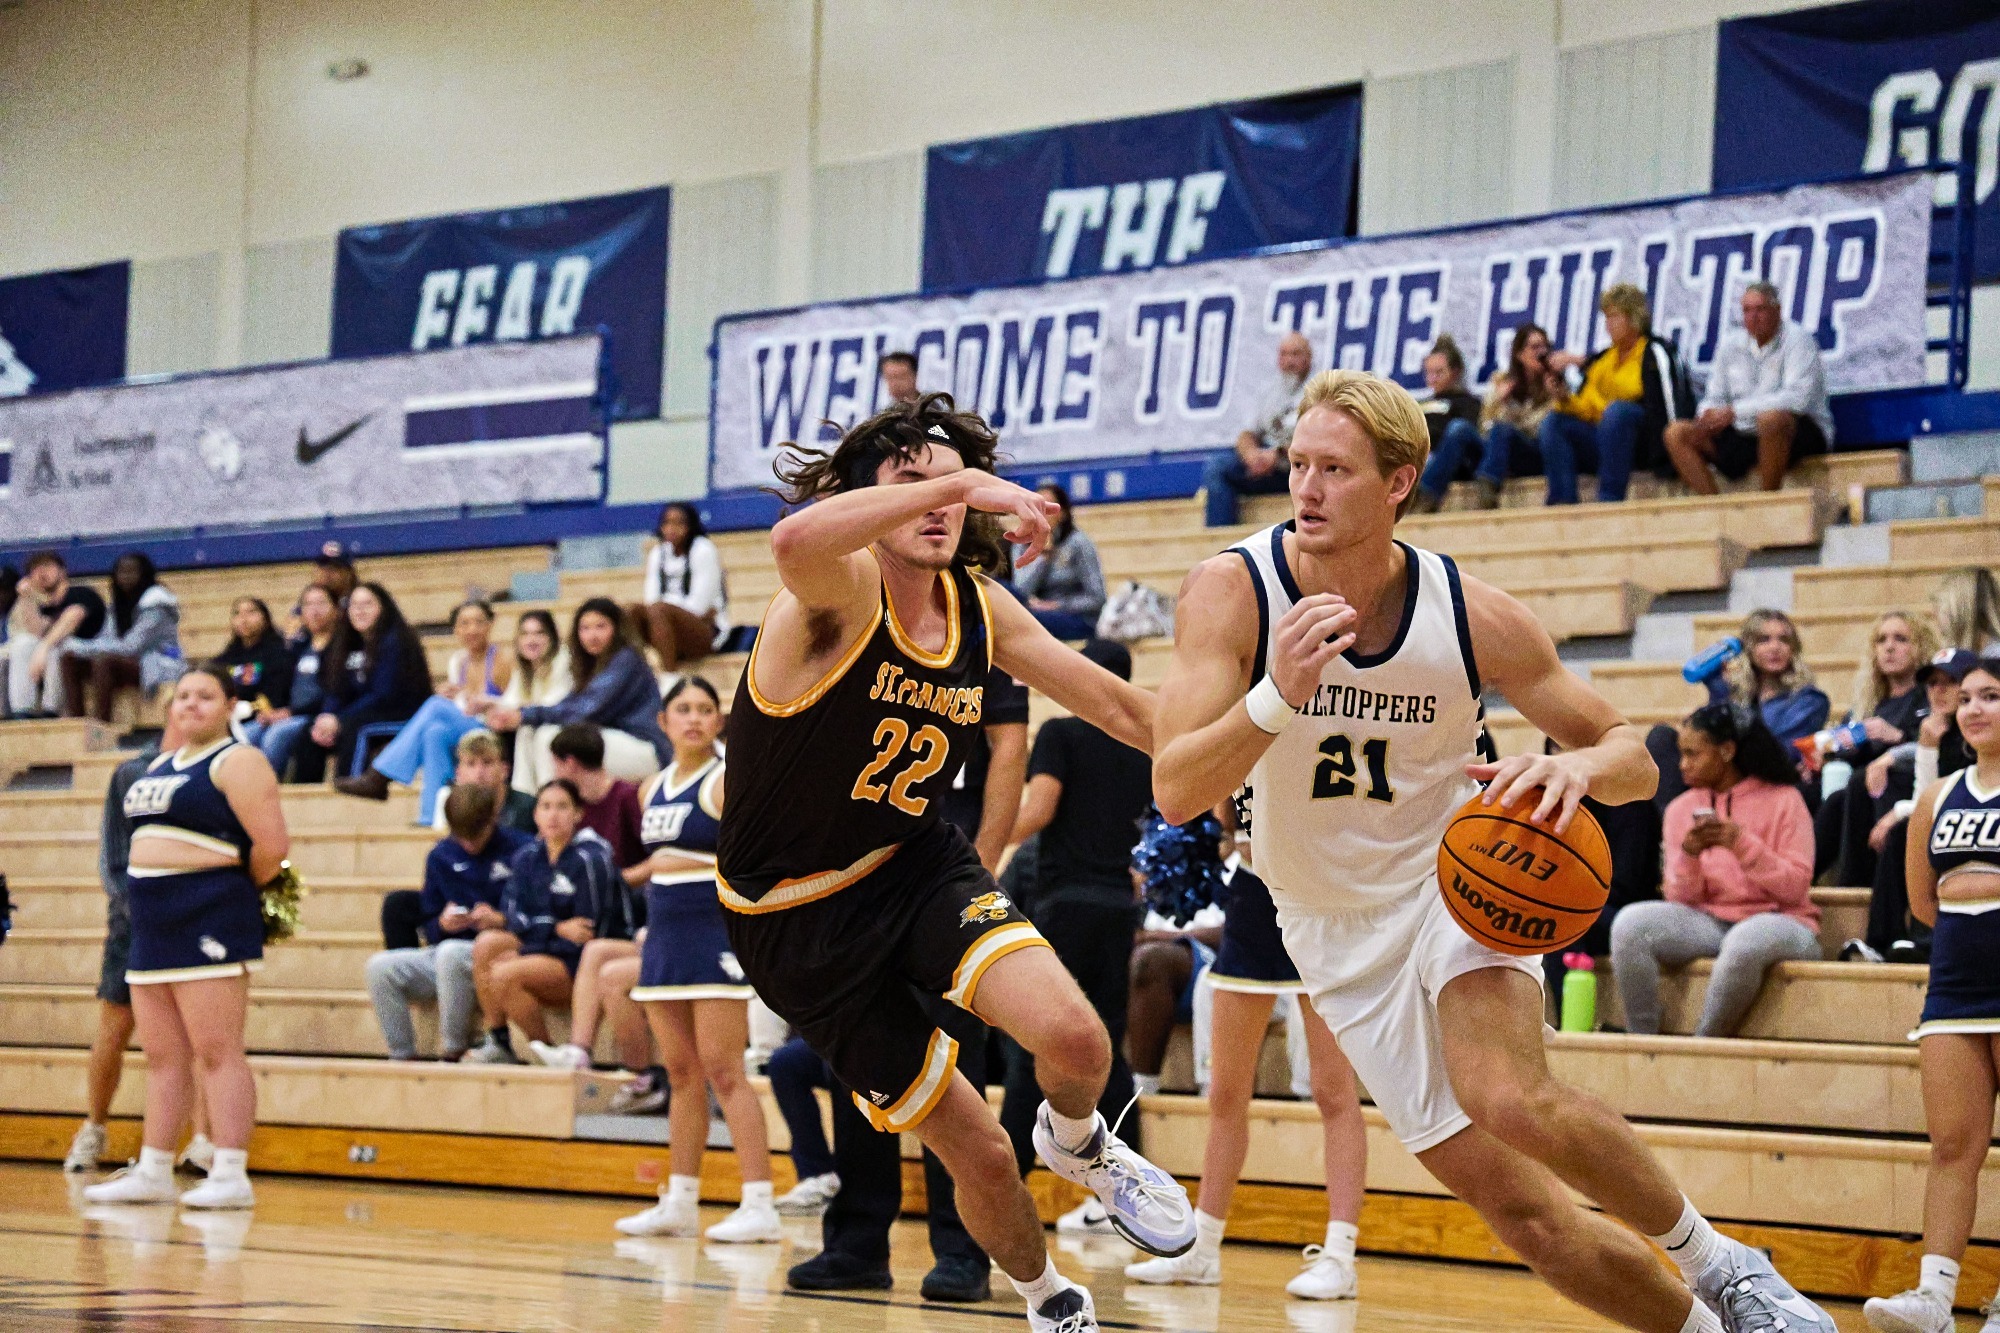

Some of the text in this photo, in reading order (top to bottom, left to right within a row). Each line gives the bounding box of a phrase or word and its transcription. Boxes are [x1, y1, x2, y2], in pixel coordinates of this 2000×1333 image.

[1042, 170, 1227, 278] THE
[411, 254, 593, 350] FEAR
[752, 307, 1103, 452] WELCOME
[1132, 291, 1239, 418] TO
[1268, 267, 1446, 392] THE
[1295, 684, 1437, 724] LTOPPERS
[123, 774, 191, 817] SEU
[851, 717, 949, 816] 22
[1310, 731, 1395, 805] 21
[641, 802, 694, 844] SEU
[1468, 840, 1558, 881] EVO NXT
[1452, 870, 1557, 940] Wilson
